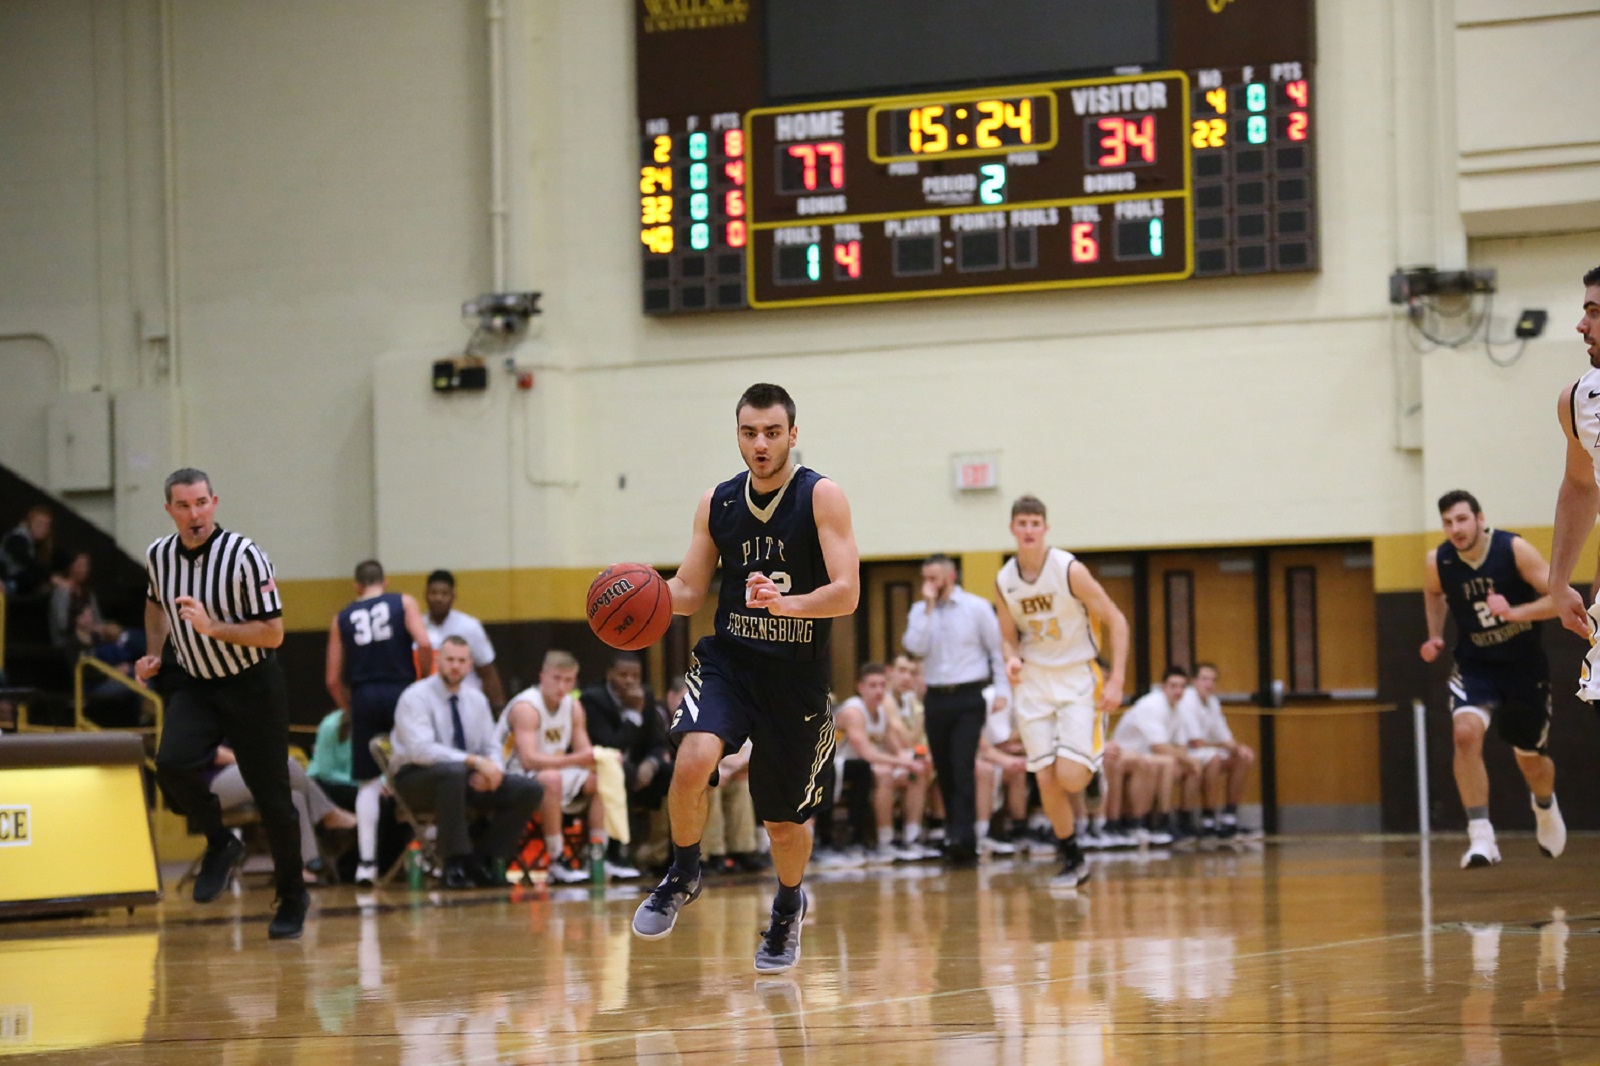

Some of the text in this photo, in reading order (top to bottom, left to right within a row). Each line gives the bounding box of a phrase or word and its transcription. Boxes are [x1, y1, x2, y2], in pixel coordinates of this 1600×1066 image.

[1270, 61, 1302, 82] PTS
[1070, 81, 1167, 116] VISITOR
[1206, 80, 1308, 114] 4 0 4
[775, 111, 844, 142] HOME
[909, 99, 1032, 153] 15:24
[1097, 115, 1156, 168] 34
[1191, 111, 1308, 149] 22 0 2
[654, 135, 672, 163] 2
[725, 160, 745, 186] 4
[788, 142, 844, 191] 77
[1083, 172, 1137, 194] BONUS
[922, 174, 978, 194] PERIOD
[979, 163, 1006, 205] 2
[725, 189, 746, 217] 6
[796, 195, 847, 216] BONUS
[726, 219, 747, 248] 0
[773, 226, 821, 246] FOULS
[884, 216, 941, 238] PLAYER
[951, 211, 1006, 232] POINTS
[1010, 207, 1060, 228] FOULS
[1114, 199, 1164, 220] FOULS
[1071, 218, 1163, 263] 6 1
[806, 240, 861, 281] 1 4
[741, 536, 786, 566] PITT
[588, 577, 635, 620] Wilson
[1021, 593, 1053, 615] BW
[349, 600, 394, 647] 32
[726, 612, 814, 644] GREENSBURG
